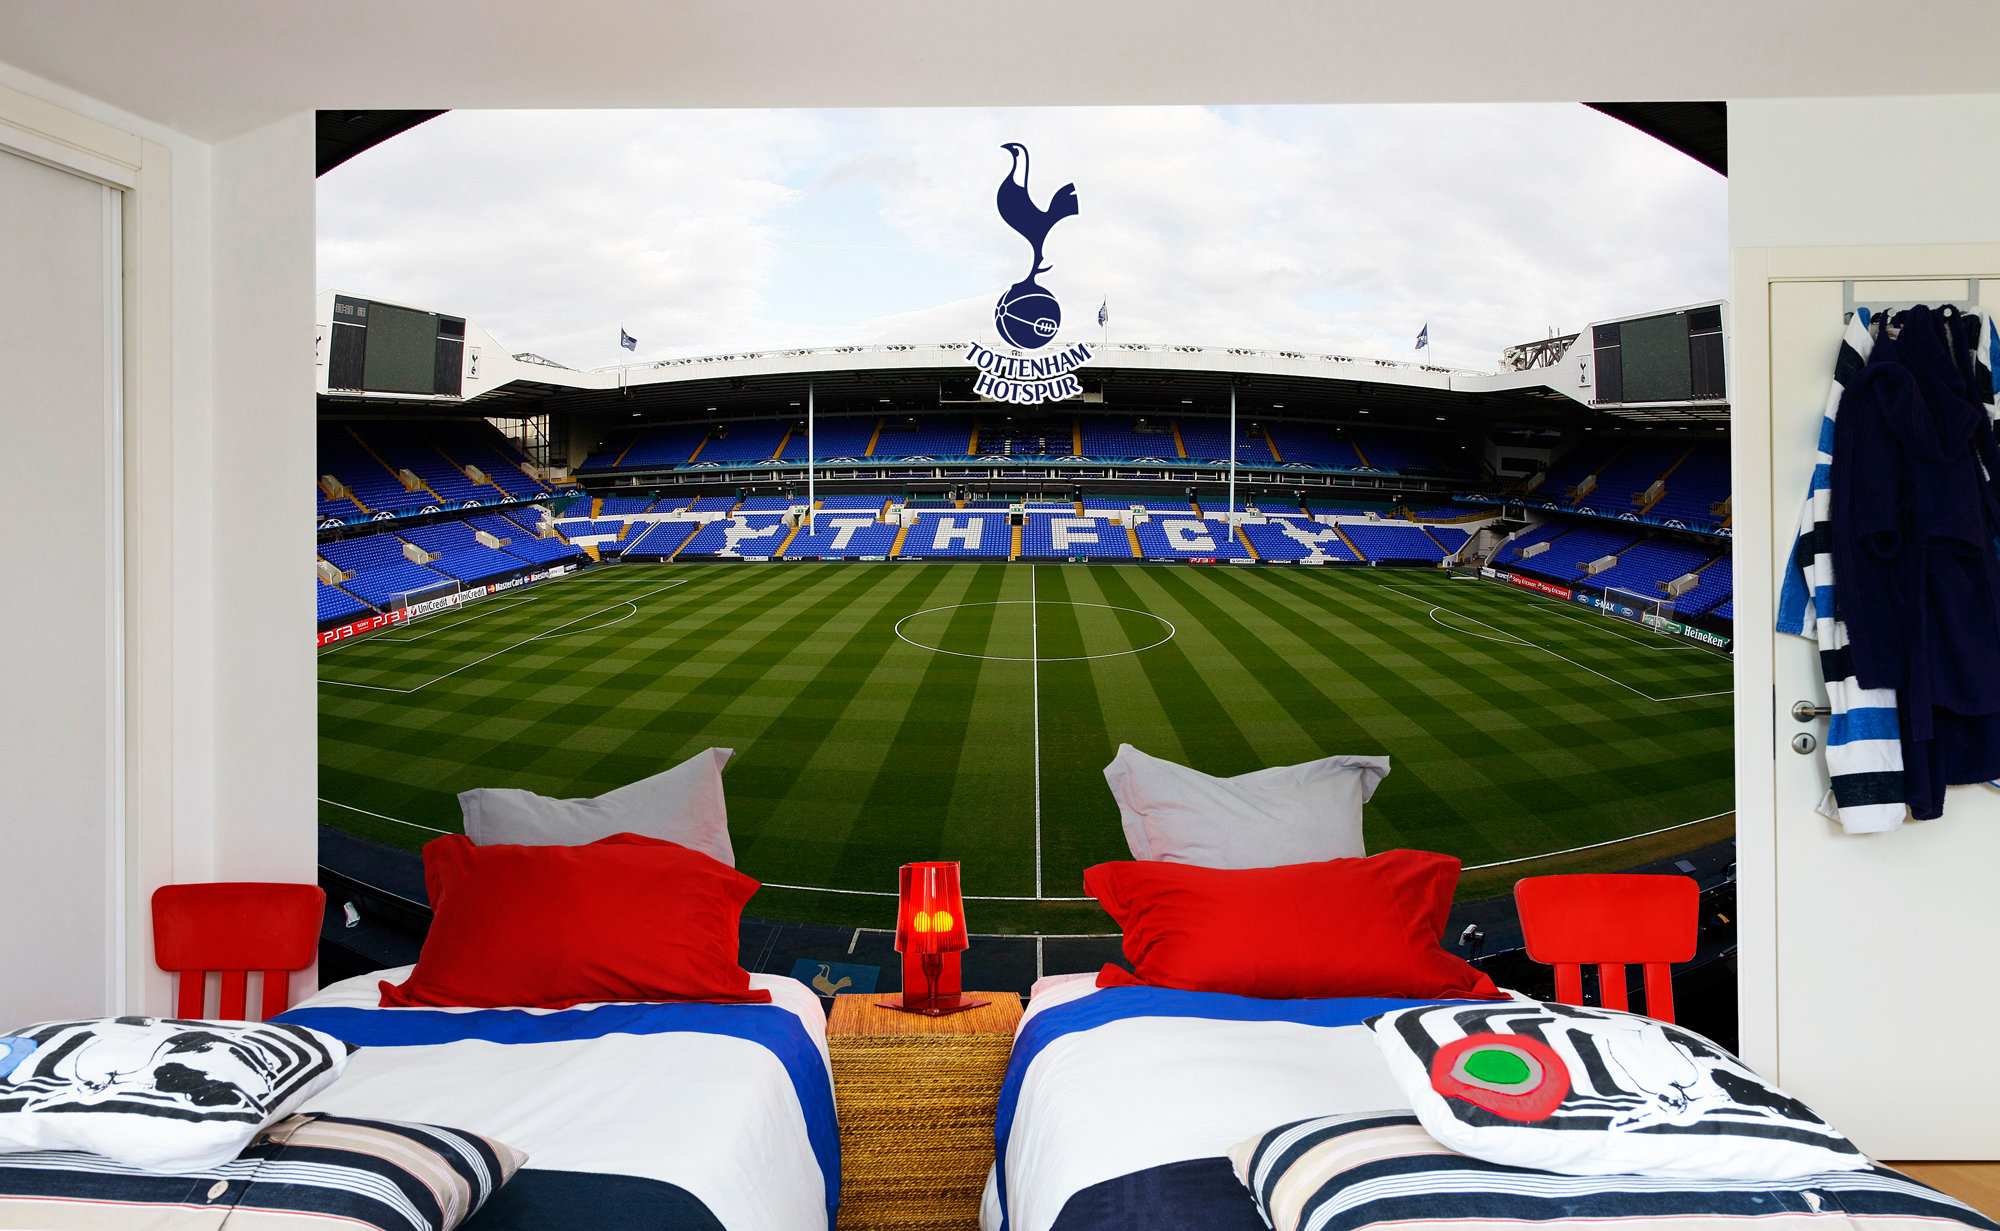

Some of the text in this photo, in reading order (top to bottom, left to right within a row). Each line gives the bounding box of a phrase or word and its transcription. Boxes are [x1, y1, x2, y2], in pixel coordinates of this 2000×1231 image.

[966, 341, 1092, 377] TOTTENHAM
[976, 374, 1081, 402] HOTSPUR
[495, 577, 523, 592] MasterCard
[418, 597, 448, 613] UniCredit
[373, 611, 400, 627] PS3
[324, 625, 353, 643] PS3
[1684, 625, 1723, 648] Heineken
